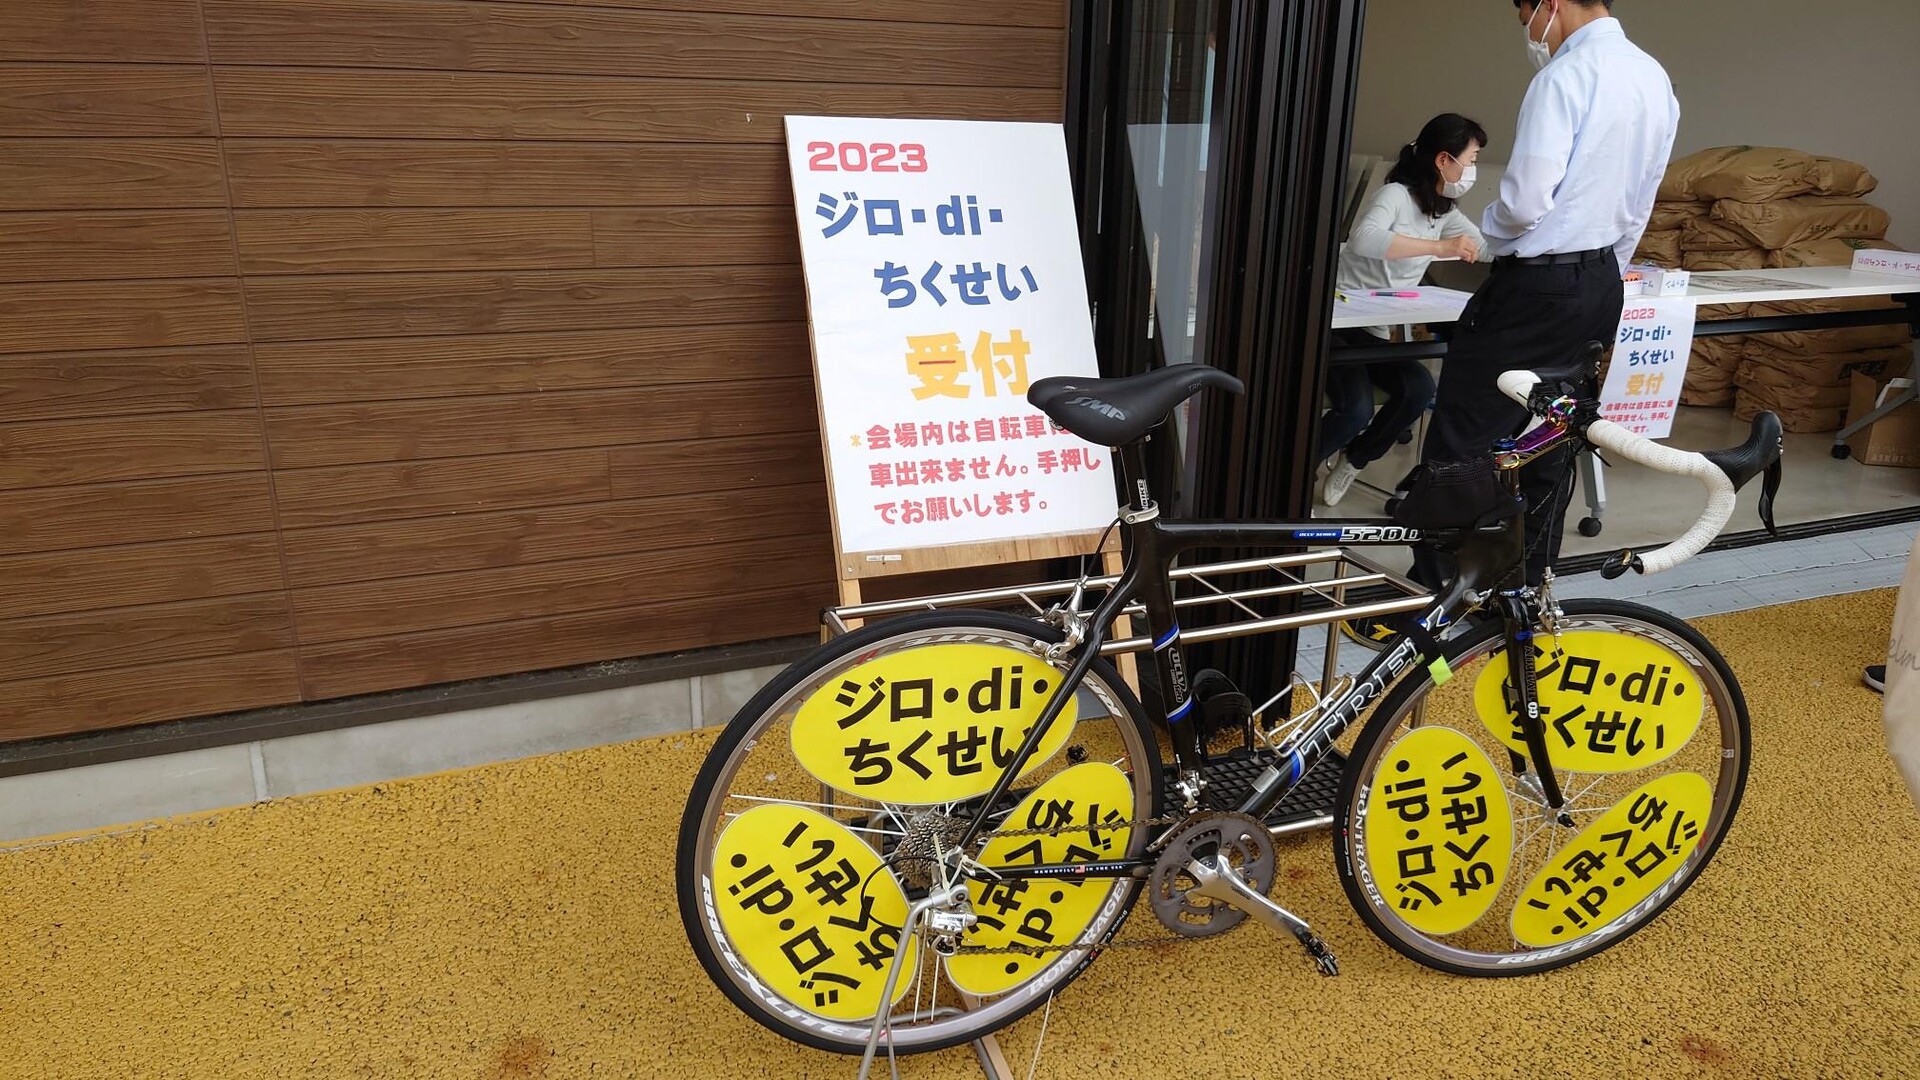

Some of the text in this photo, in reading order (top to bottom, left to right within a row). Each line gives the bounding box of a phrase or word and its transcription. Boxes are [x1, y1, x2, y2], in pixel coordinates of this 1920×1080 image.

[807, 141, 929, 173] 2023
[815, 191, 1003, 239] ジロ・di・
[873, 260, 1039, 308] ちくせい
[1622, 308, 1655, 321] 2023
[905, 329, 1031, 401] 受付
[1628, 349, 1674, 367] ちくせい
[1625, 372, 1665, 396] 受付
[1065, 396, 1125, 421] SMP
[874, 489, 1048, 526] でお願いします。
[1339, 526, 1422, 542] 5200
[835, 665, 1050, 730] ジロ・di・
[844, 724, 1040, 786] ちくせい
[1354, 784, 1385, 909] BONTRAGER
[1441, 751, 1496, 898] ちくせい
[1527, 792, 1668, 911] ちくせい
[782, 821, 900, 971] ちくせい
